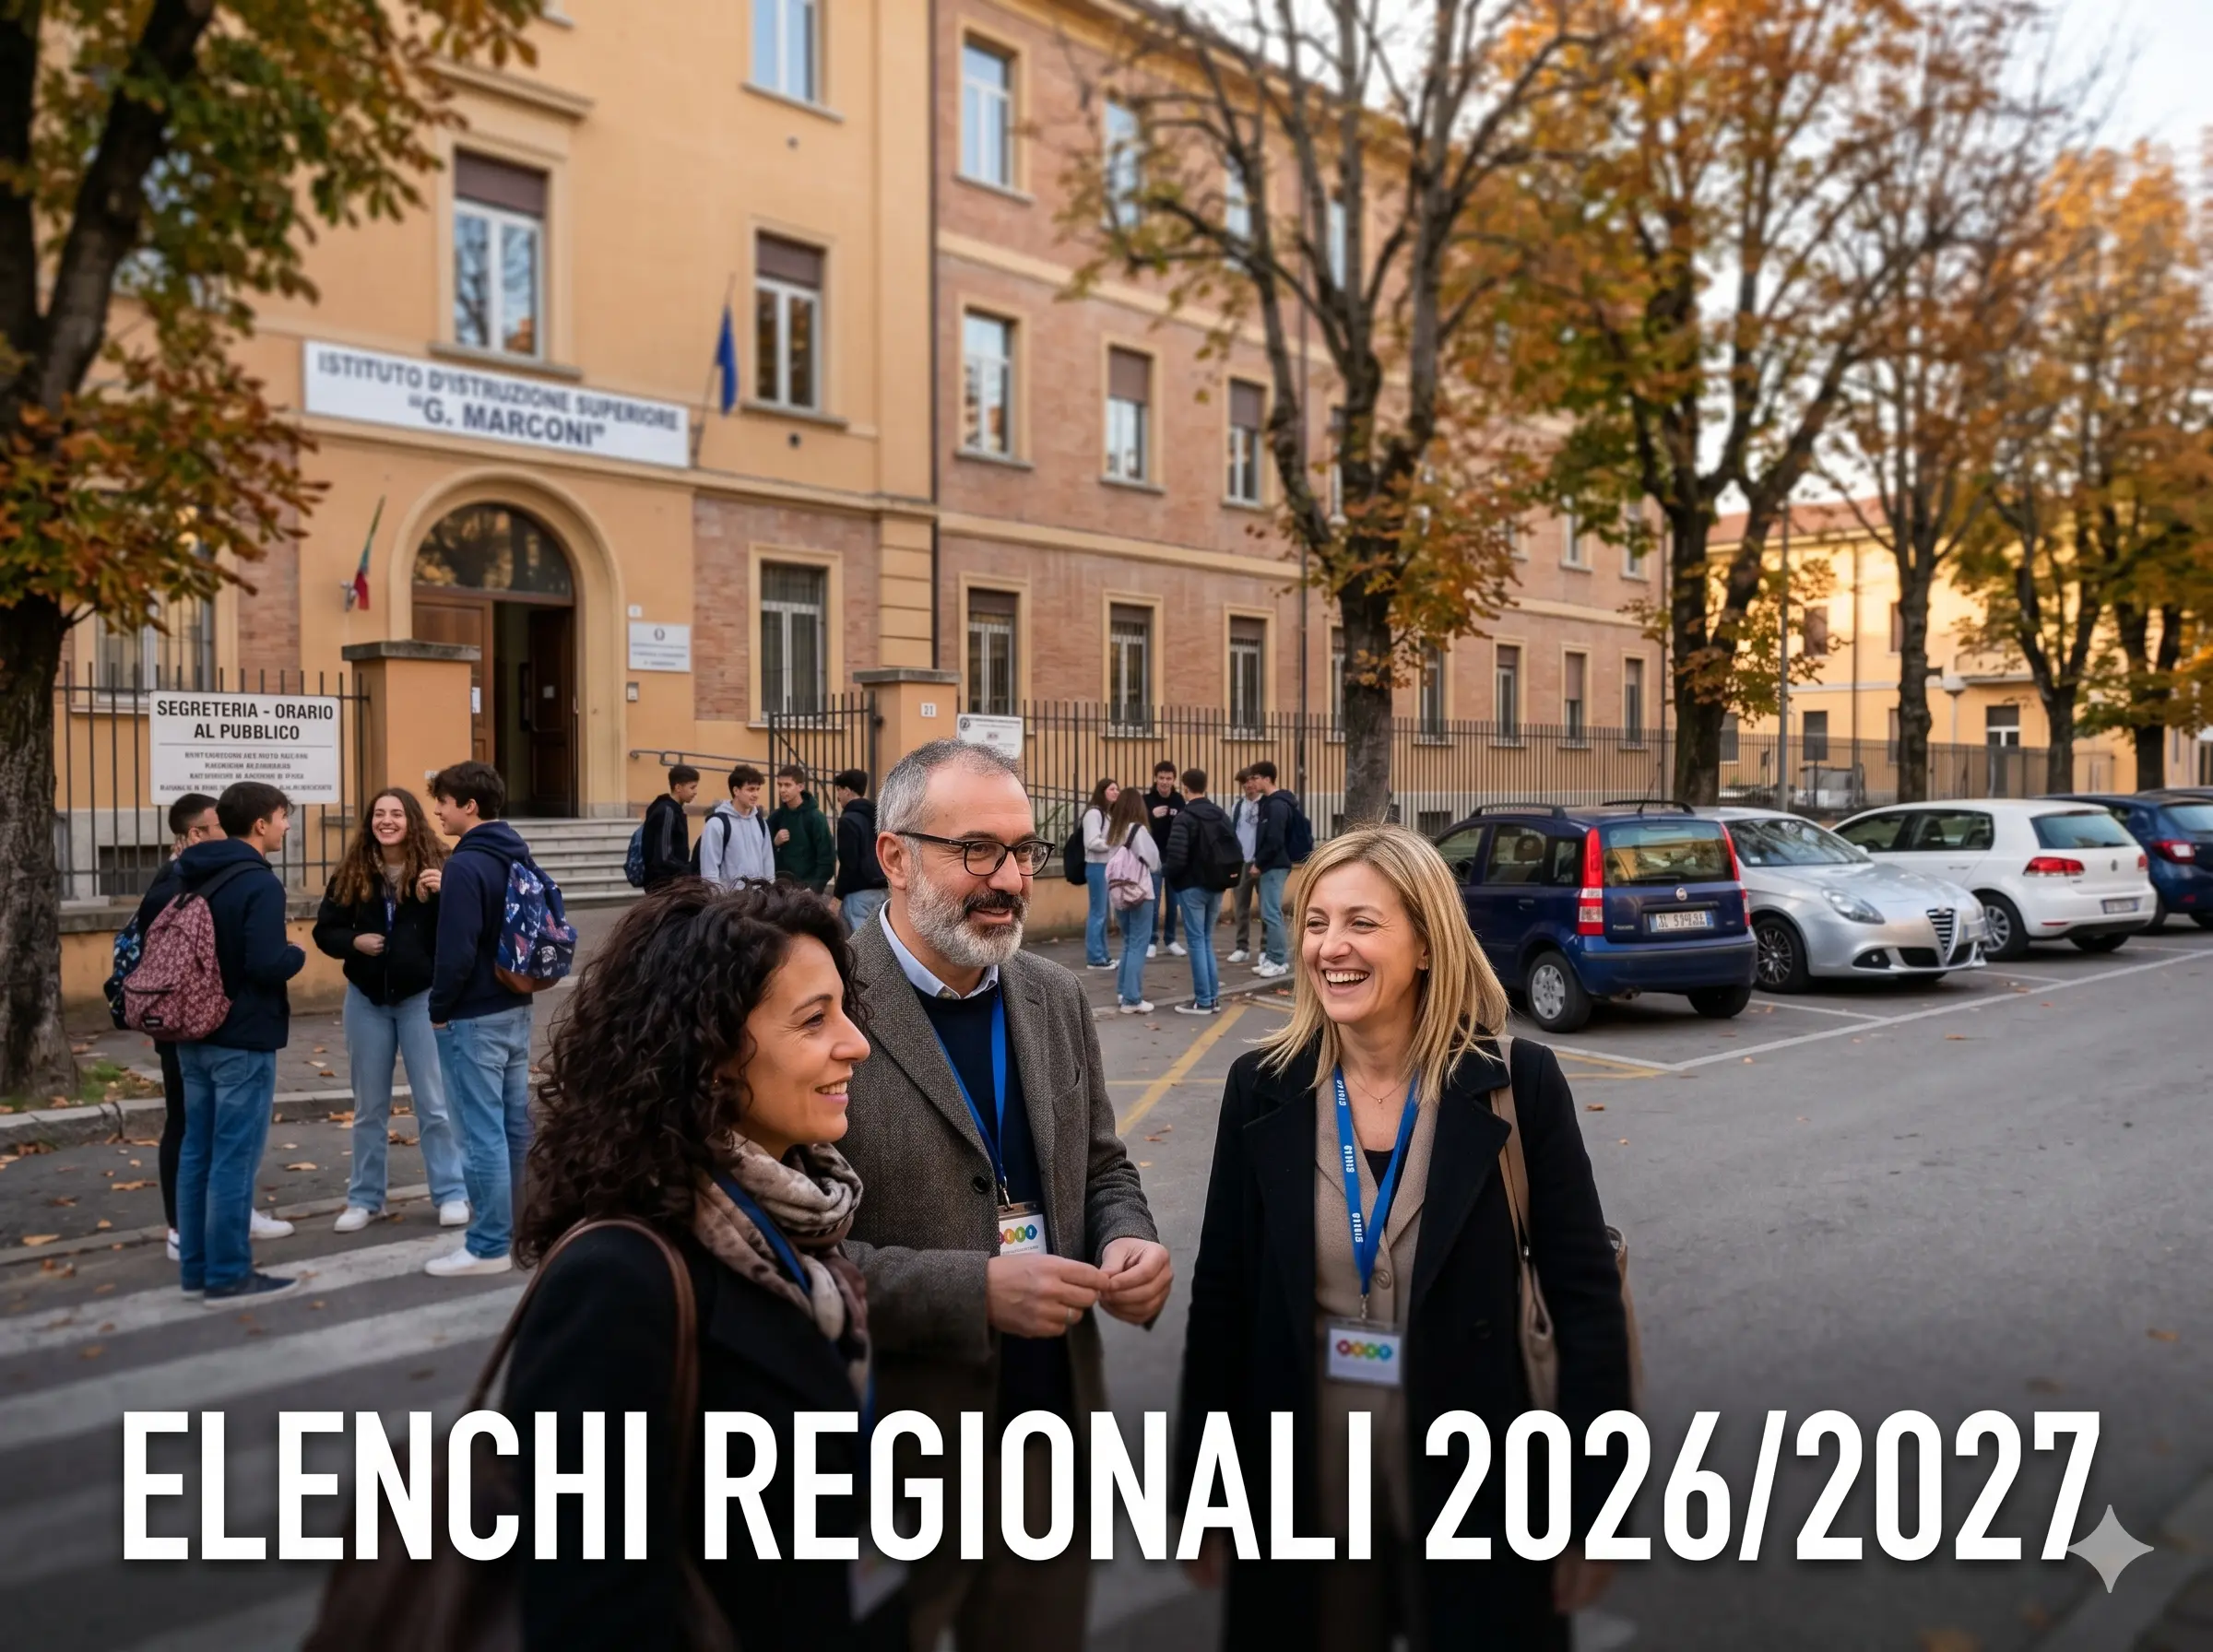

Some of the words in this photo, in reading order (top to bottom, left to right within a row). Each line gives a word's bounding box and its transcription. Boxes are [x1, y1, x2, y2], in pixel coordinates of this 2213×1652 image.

[317, 351, 423, 389] ISTITUTO
[576, 395, 680, 431] SUPERIORE
[157, 700, 258, 718] SEGRETERIA
[275, 703, 334, 720] ORARIO
[194, 724, 216, 738] AL
[220, 724, 300, 740] PUBBLICO
